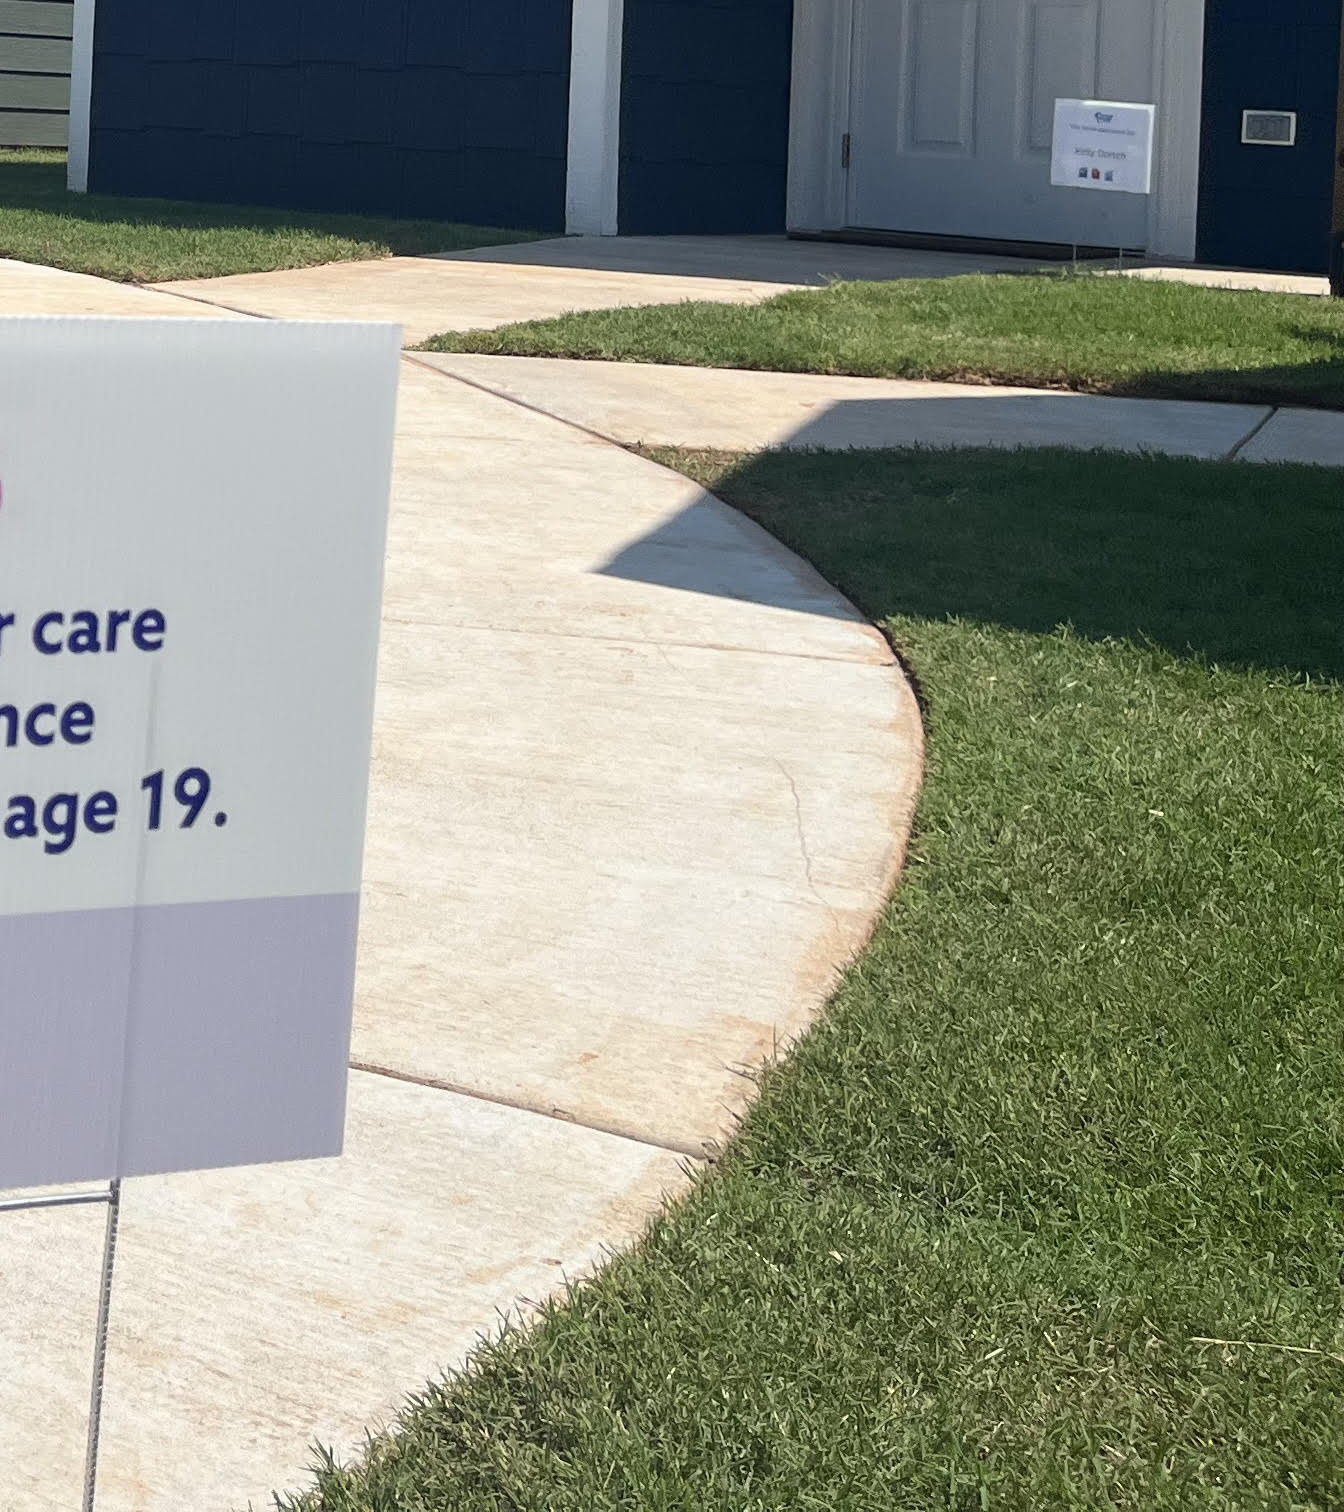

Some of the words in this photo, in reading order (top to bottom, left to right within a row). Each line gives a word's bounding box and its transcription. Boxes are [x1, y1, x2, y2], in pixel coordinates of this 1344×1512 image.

[33, 608, 166, 654] care
[4, 790, 118, 853] age
[141, 767, 228, 830] 19.
